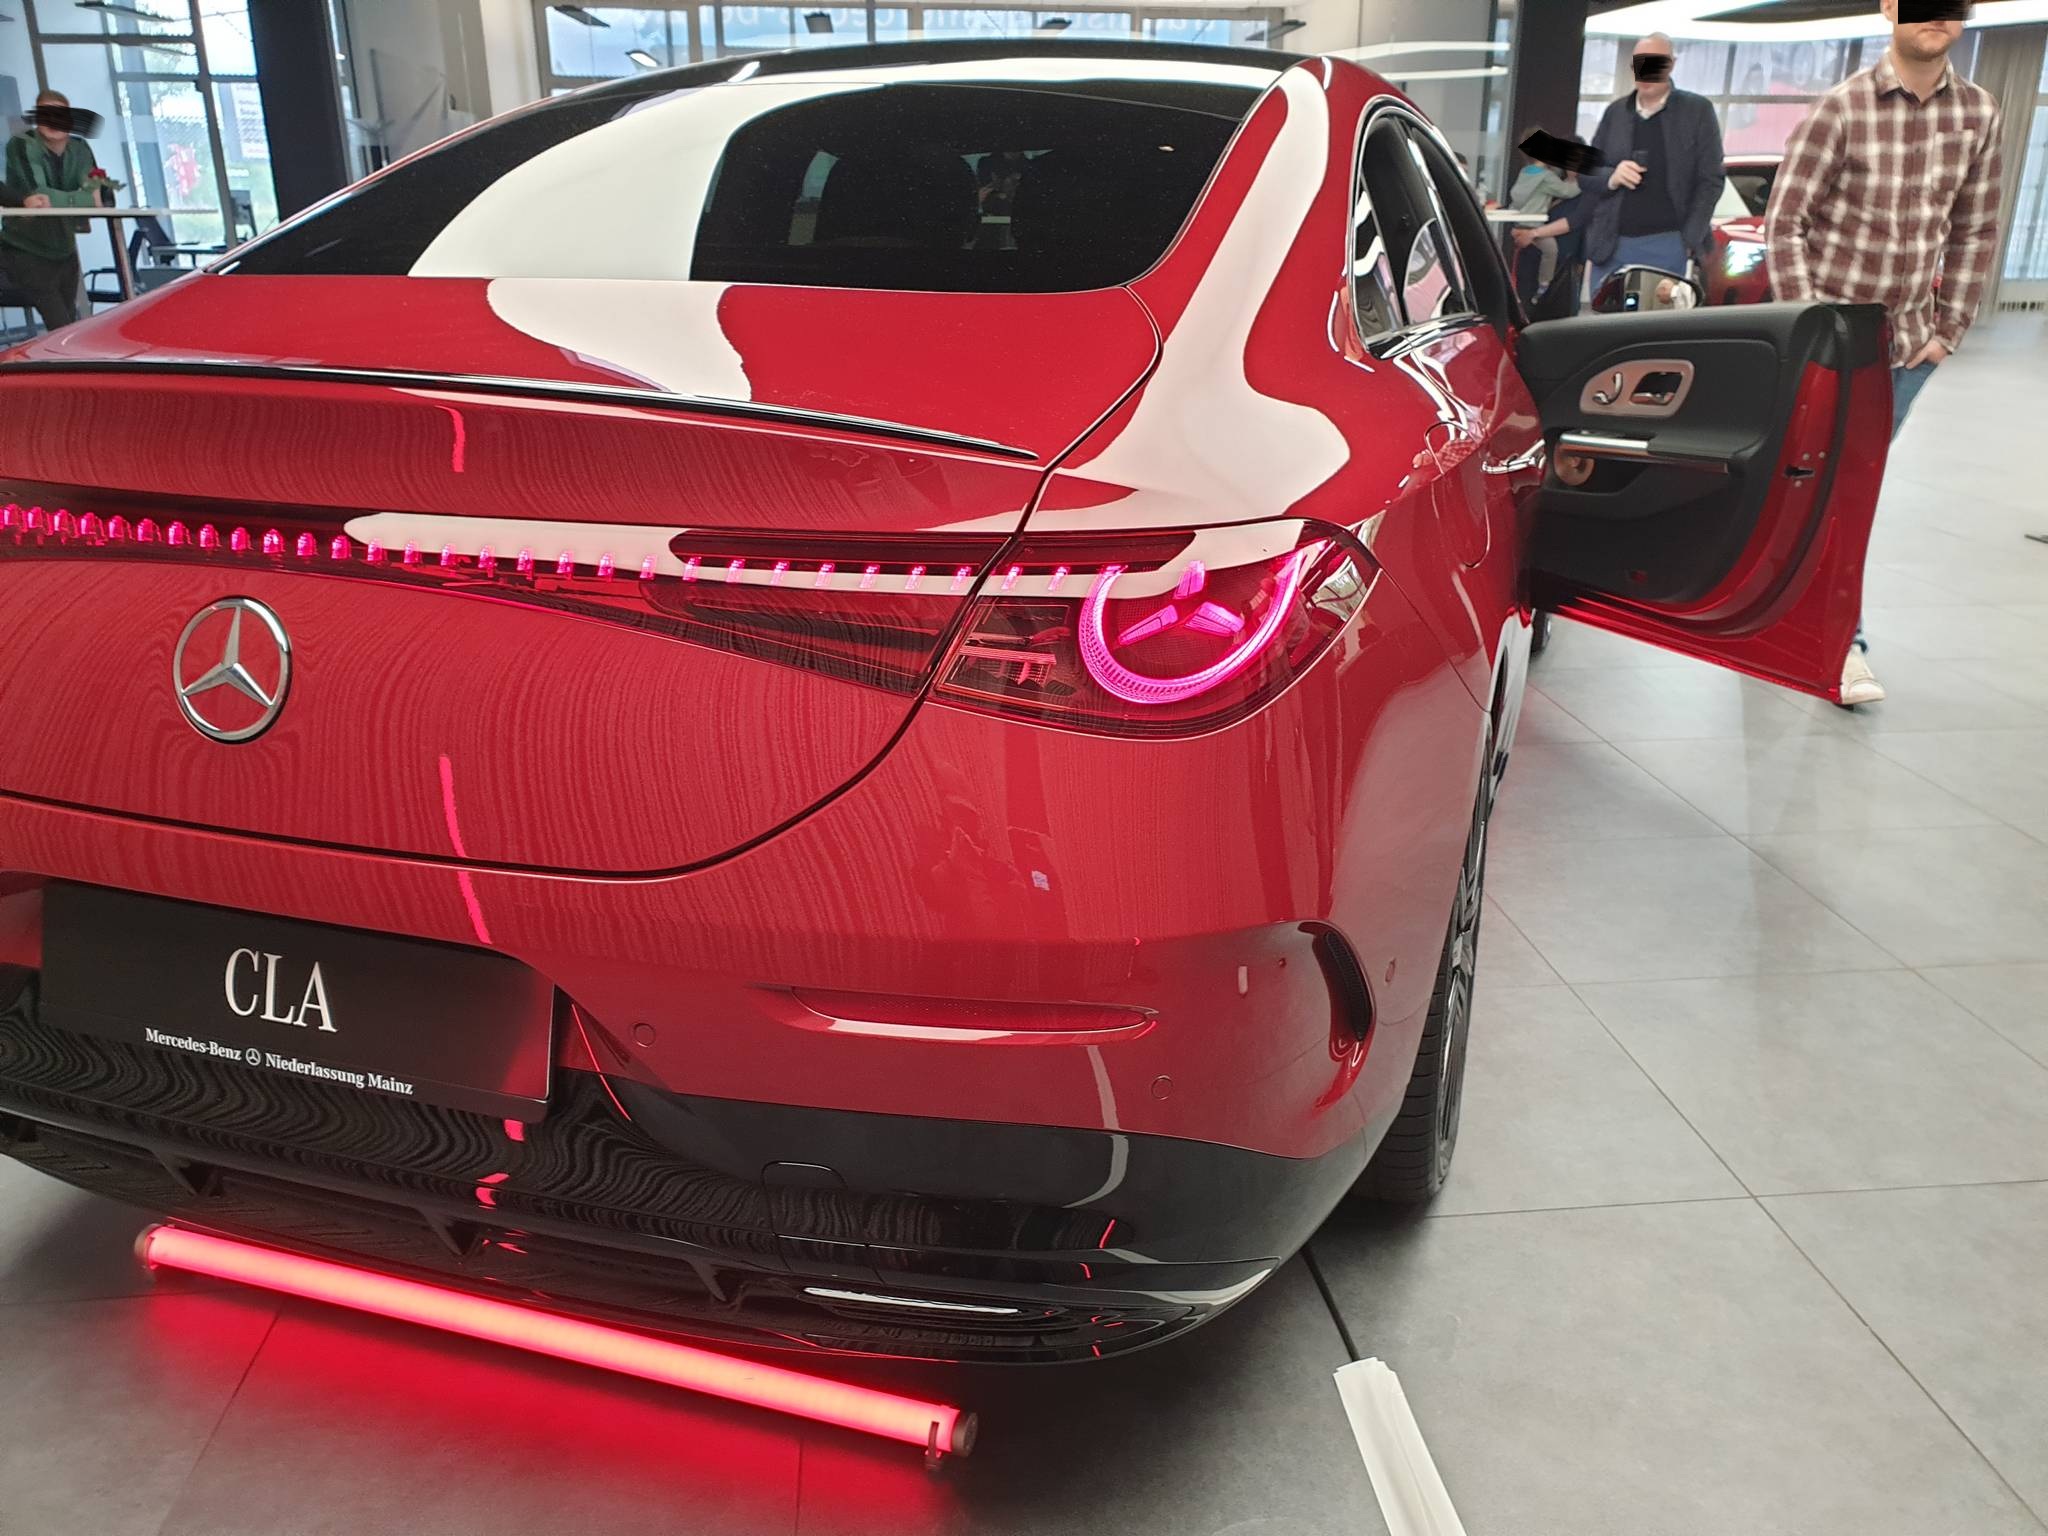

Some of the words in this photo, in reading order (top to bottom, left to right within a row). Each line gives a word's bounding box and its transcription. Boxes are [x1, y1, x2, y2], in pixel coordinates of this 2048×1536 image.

[224, 947, 338, 1033] CLA
[145, 1028, 242, 1061] Mercedes-Benz
[265, 1052, 365, 1089] Niederlassung
[367, 1073, 414, 1096] Mainz
